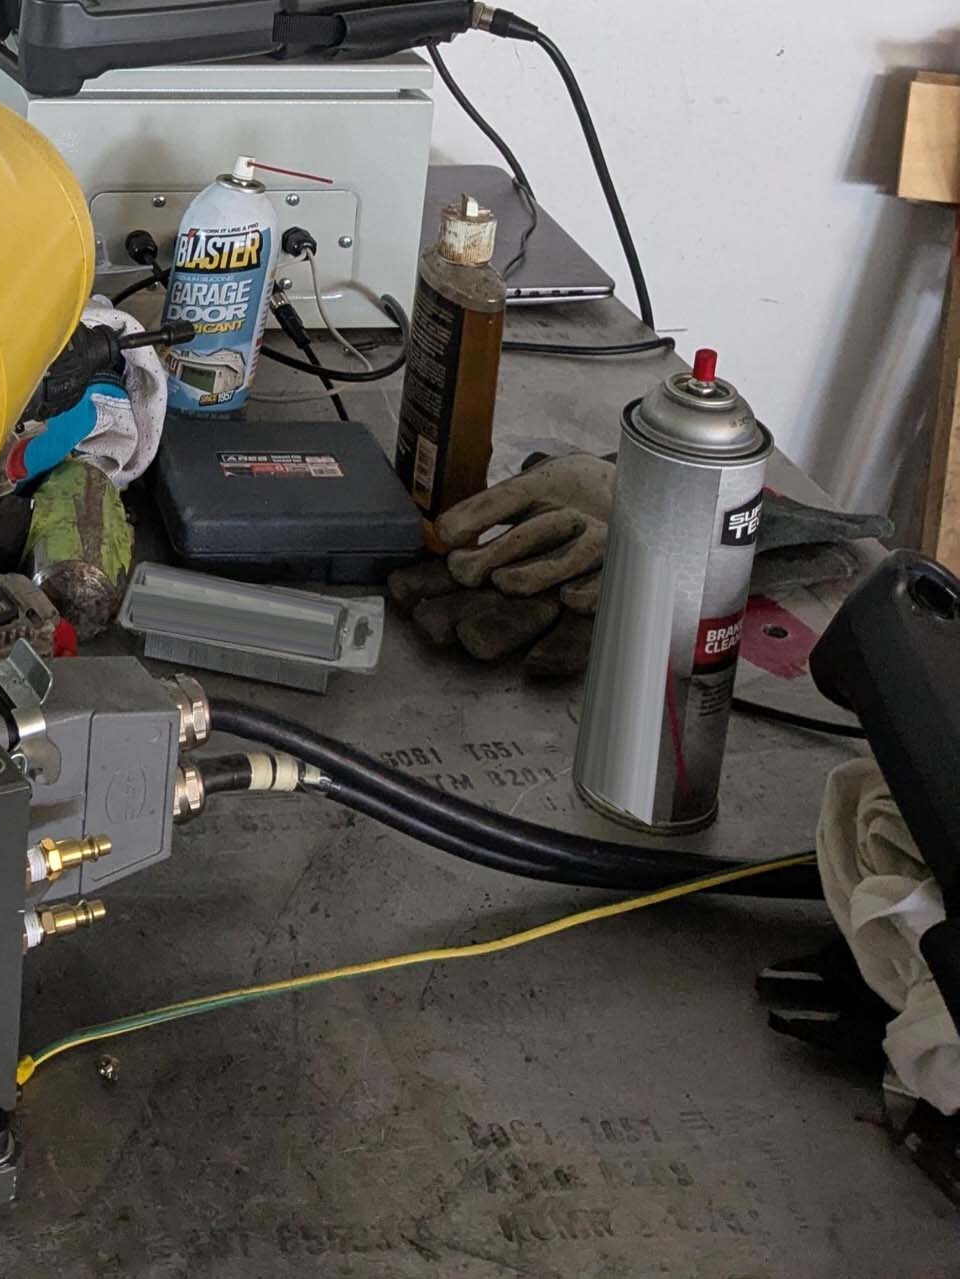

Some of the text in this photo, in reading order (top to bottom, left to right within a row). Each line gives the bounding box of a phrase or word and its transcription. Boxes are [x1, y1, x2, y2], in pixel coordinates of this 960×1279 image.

[171, 279, 252, 306] GARAGE
[166, 303, 248, 322] DOOR
[192, 319, 246, 334] RICANT
[706, 624, 742, 642] BRAK
